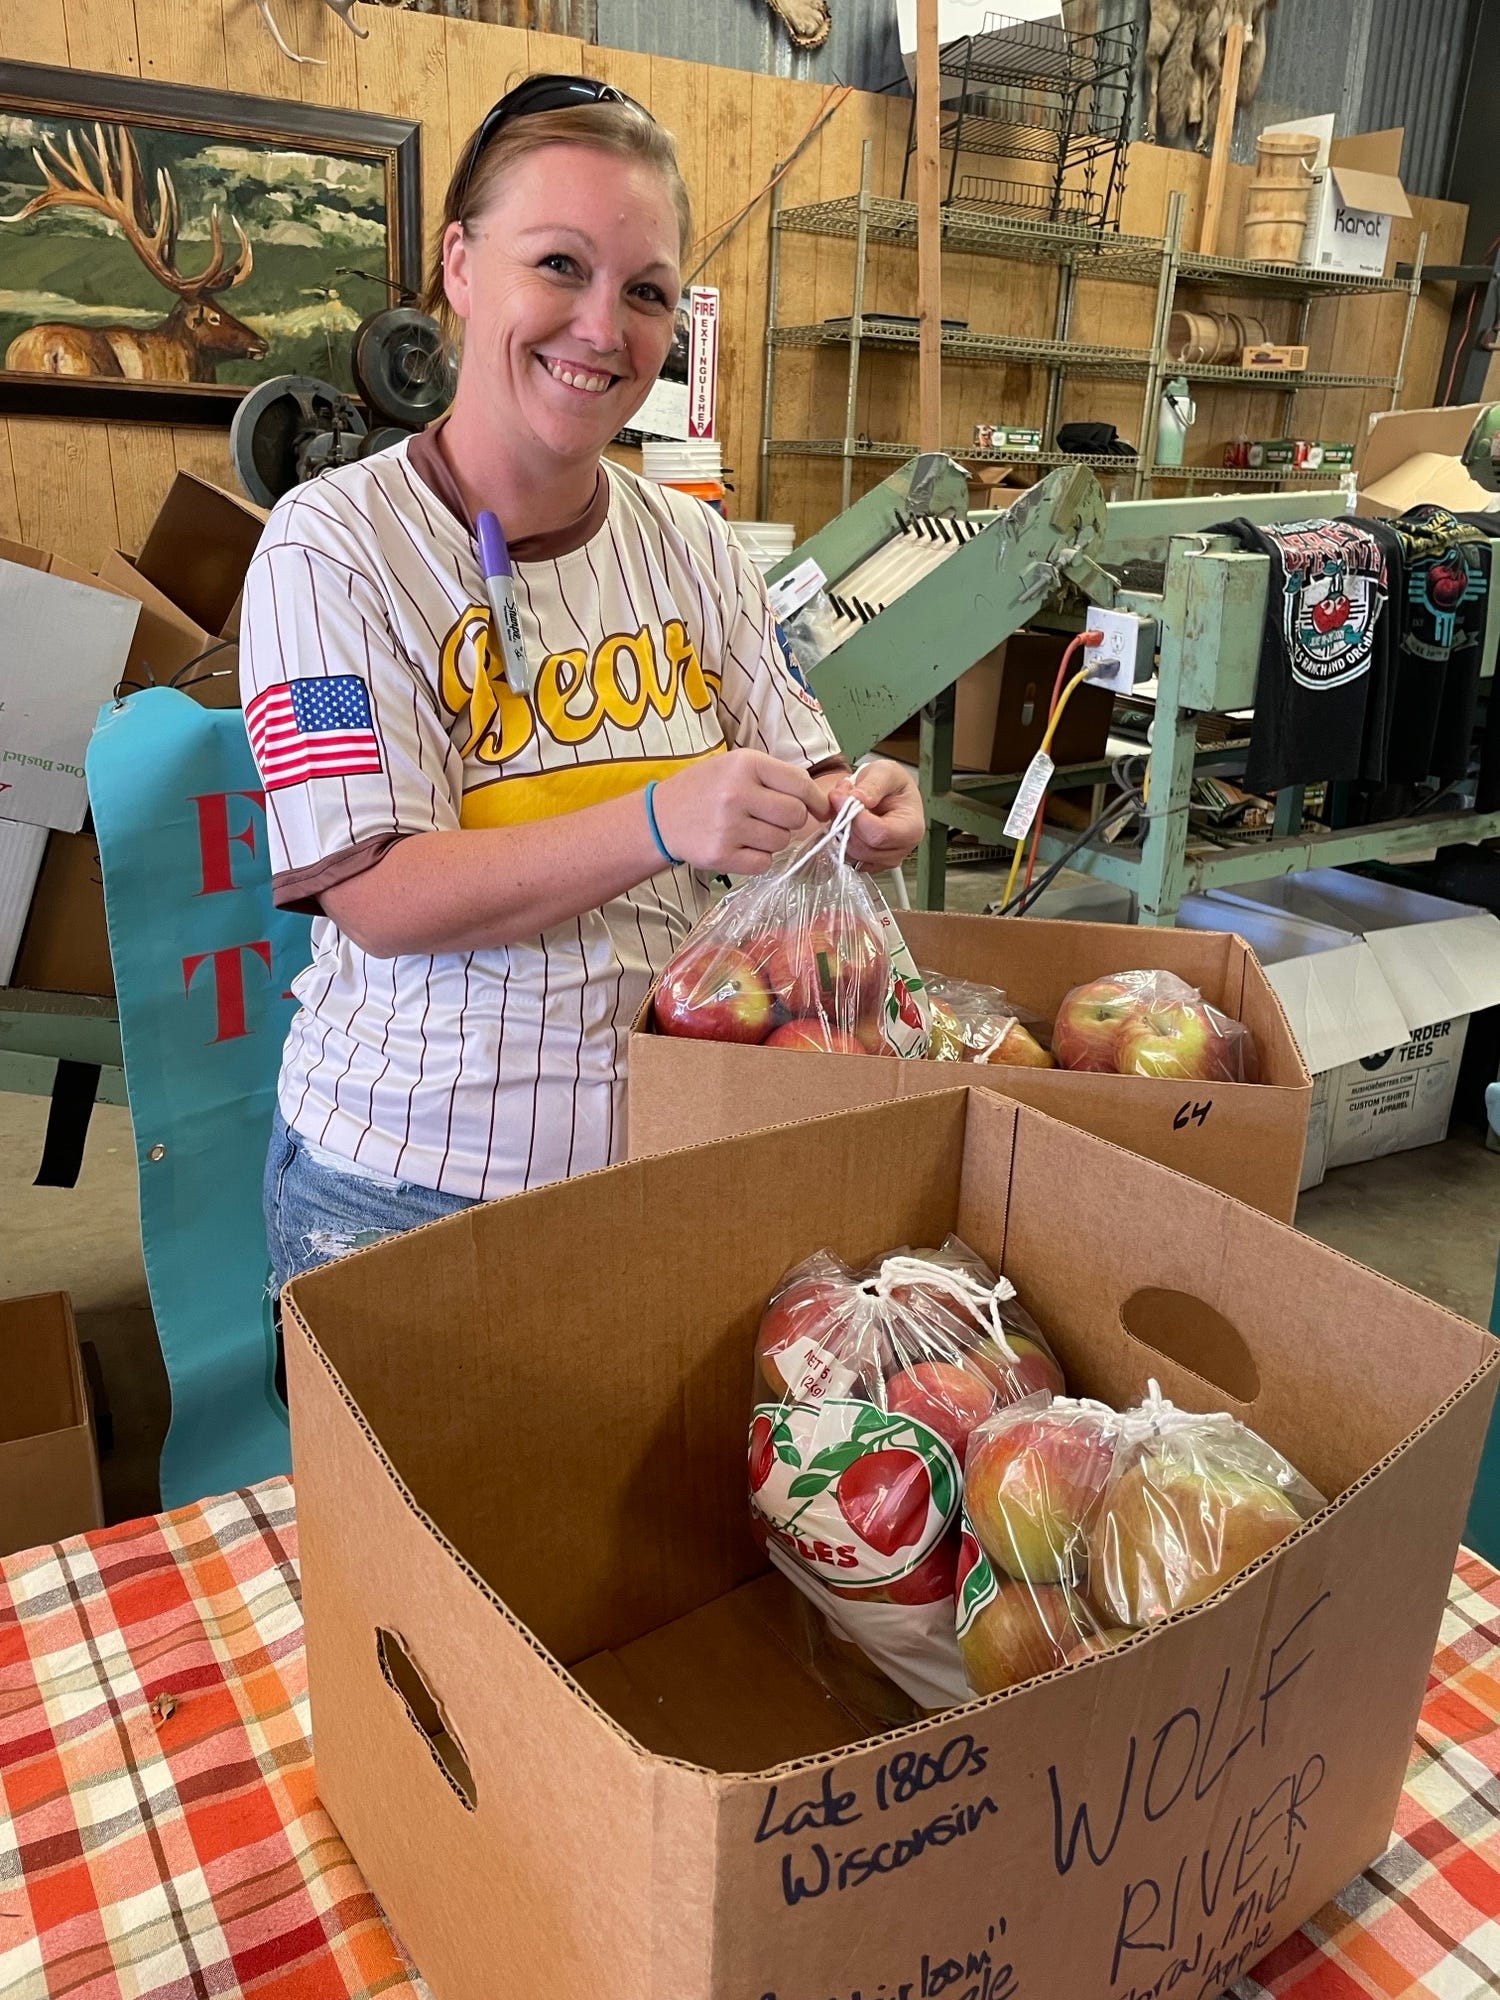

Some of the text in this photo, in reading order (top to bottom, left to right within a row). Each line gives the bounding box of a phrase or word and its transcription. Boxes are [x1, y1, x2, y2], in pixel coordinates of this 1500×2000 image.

[1334, 208, 1381, 237] Karat
[694, 301, 715, 316] FIRE
[697, 319, 709, 431] EXTINGUISHER
[3, 751, 86, 779] One Bushel
[1408, 1022, 1451, 1043] RDER
[1400, 1041, 1434, 1062] TEES
[1349, 1090, 1410, 1111] CUSTOM T-SHIRTS
[1379, 1101, 1407, 1114] APPAREL
[1173, 1100, 1212, 1131] 64
[804, 1349, 823, 1370] NET
[1048, 1591, 1331, 1876] WOLF
[754, 1734, 989, 1843] Late 1800s
[782, 1796, 998, 1905] Wisconsin
[1110, 1754, 1326, 1985] RIVER
[1196, 1921, 1273, 2000] Apple
